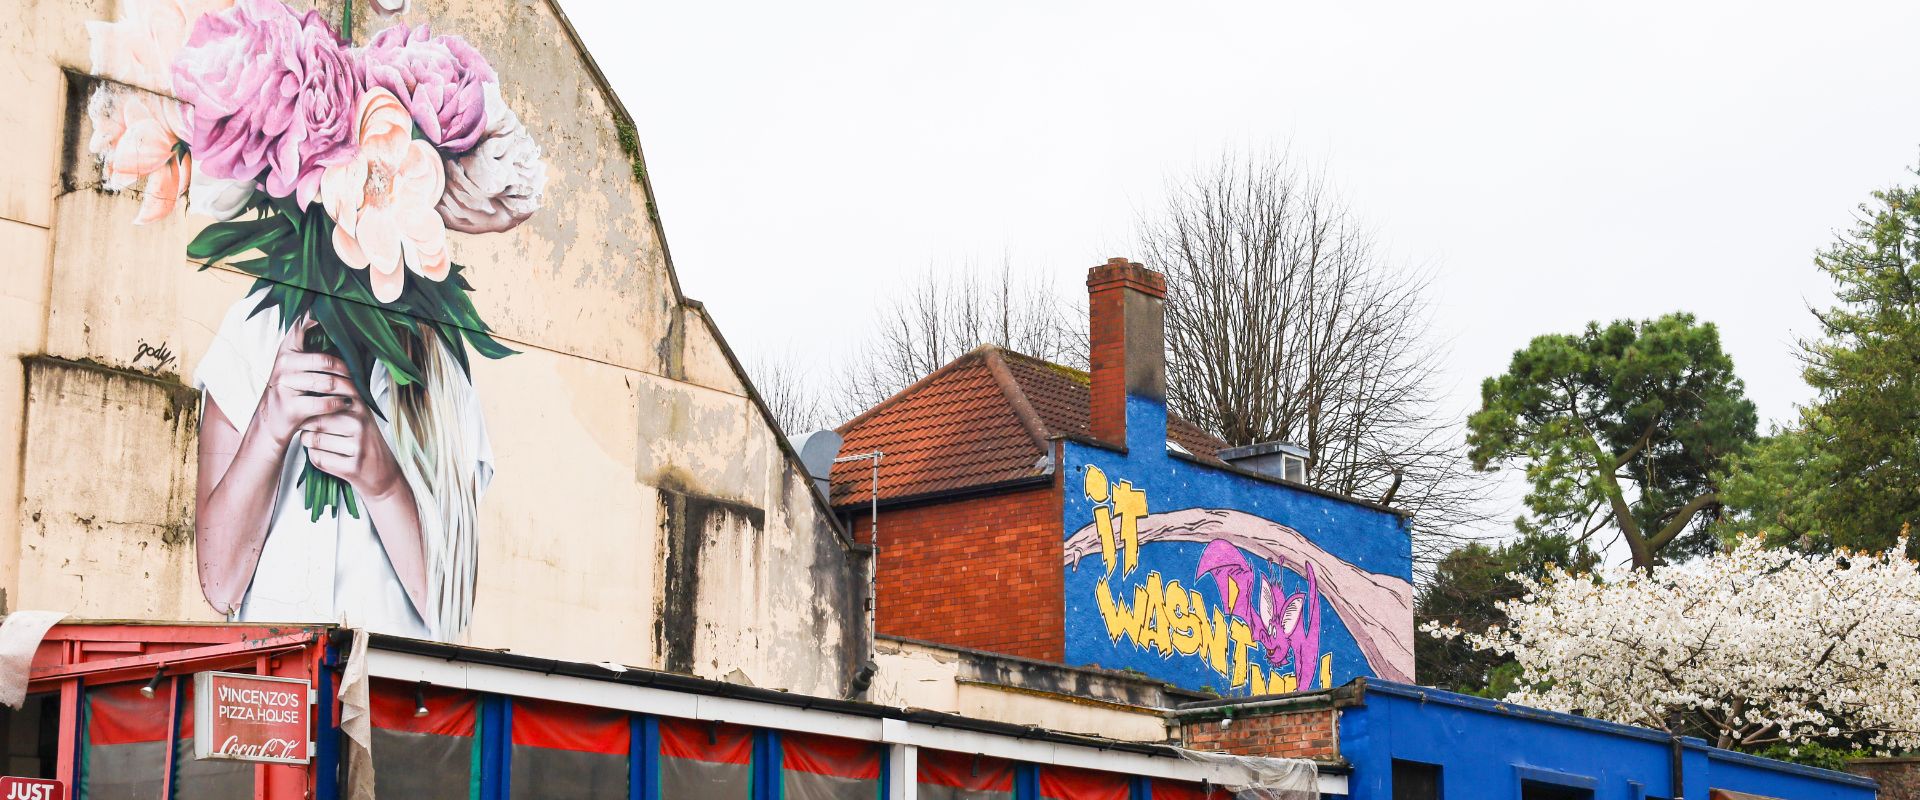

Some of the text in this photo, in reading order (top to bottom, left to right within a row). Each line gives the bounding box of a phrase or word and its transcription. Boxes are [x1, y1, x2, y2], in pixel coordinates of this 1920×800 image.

[1096, 571, 1257, 688] WASN'T
[218, 685, 299, 708] VINCENZO'S
[219, 705, 299, 724] PIZZA HOUSE
[7, 782, 54, 800] JUST
